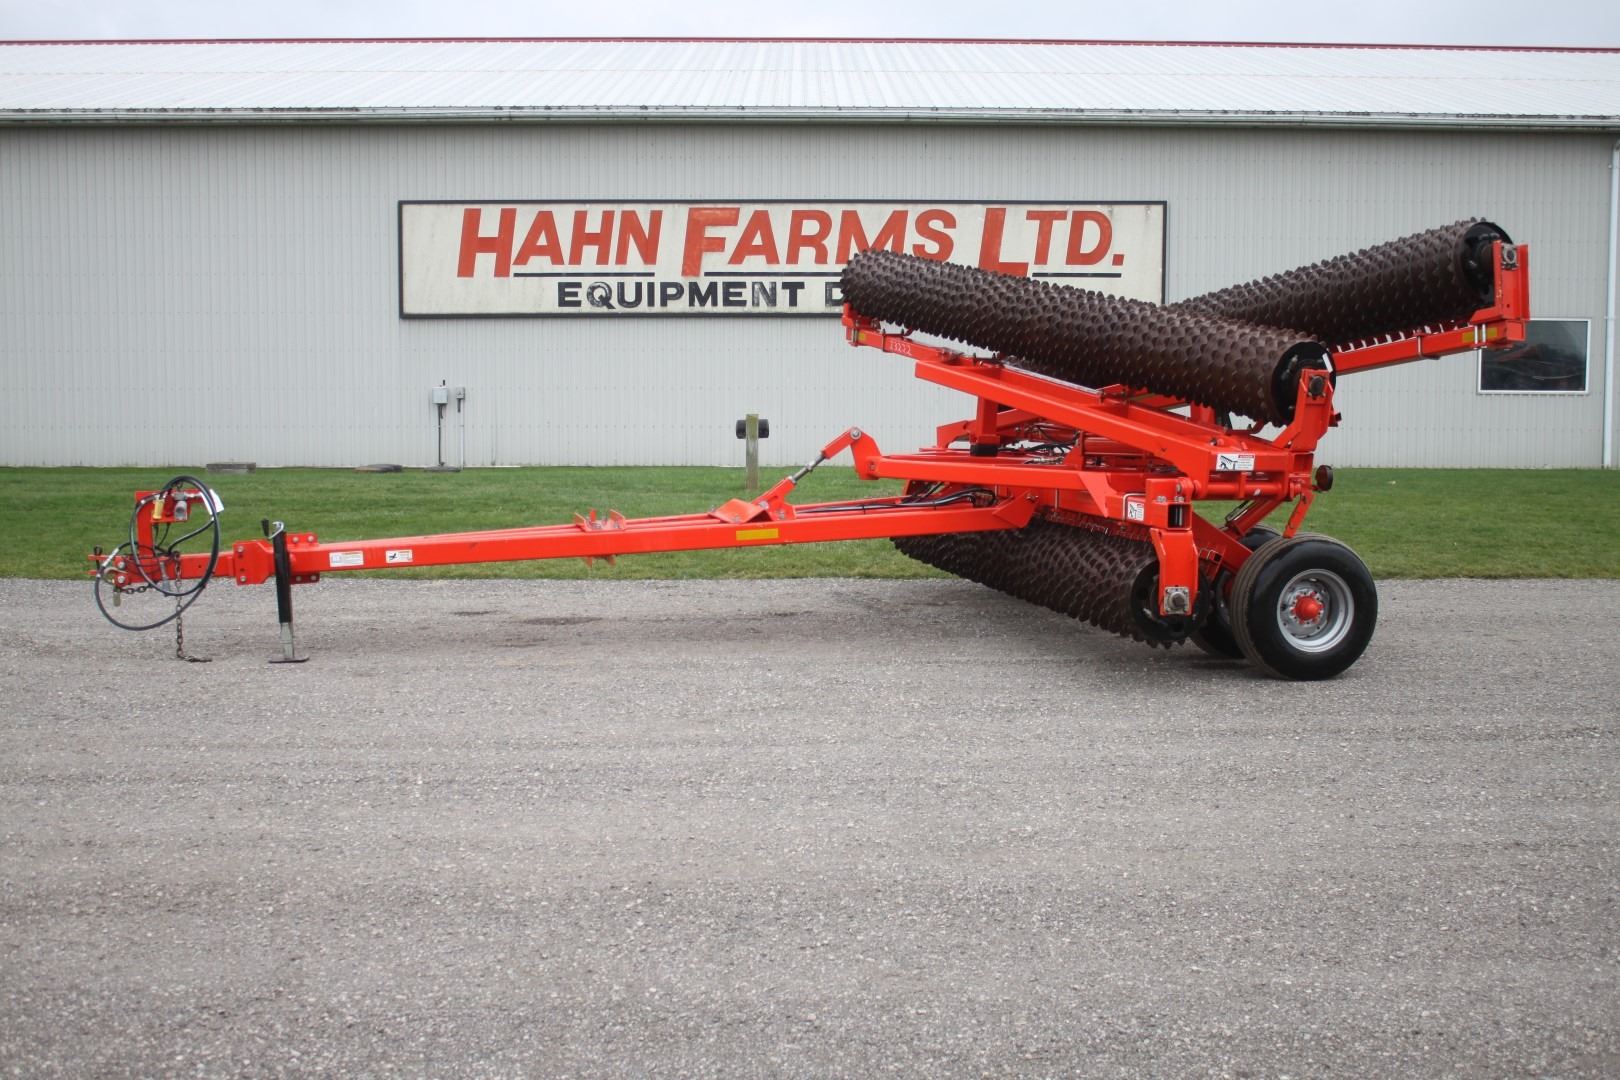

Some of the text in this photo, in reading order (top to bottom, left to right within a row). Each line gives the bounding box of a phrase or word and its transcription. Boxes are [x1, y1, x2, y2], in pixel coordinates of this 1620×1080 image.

[457, 207, 1125, 278] HAHN FARMS LTD.
[557, 281, 805, 310] EQUIPMENT
